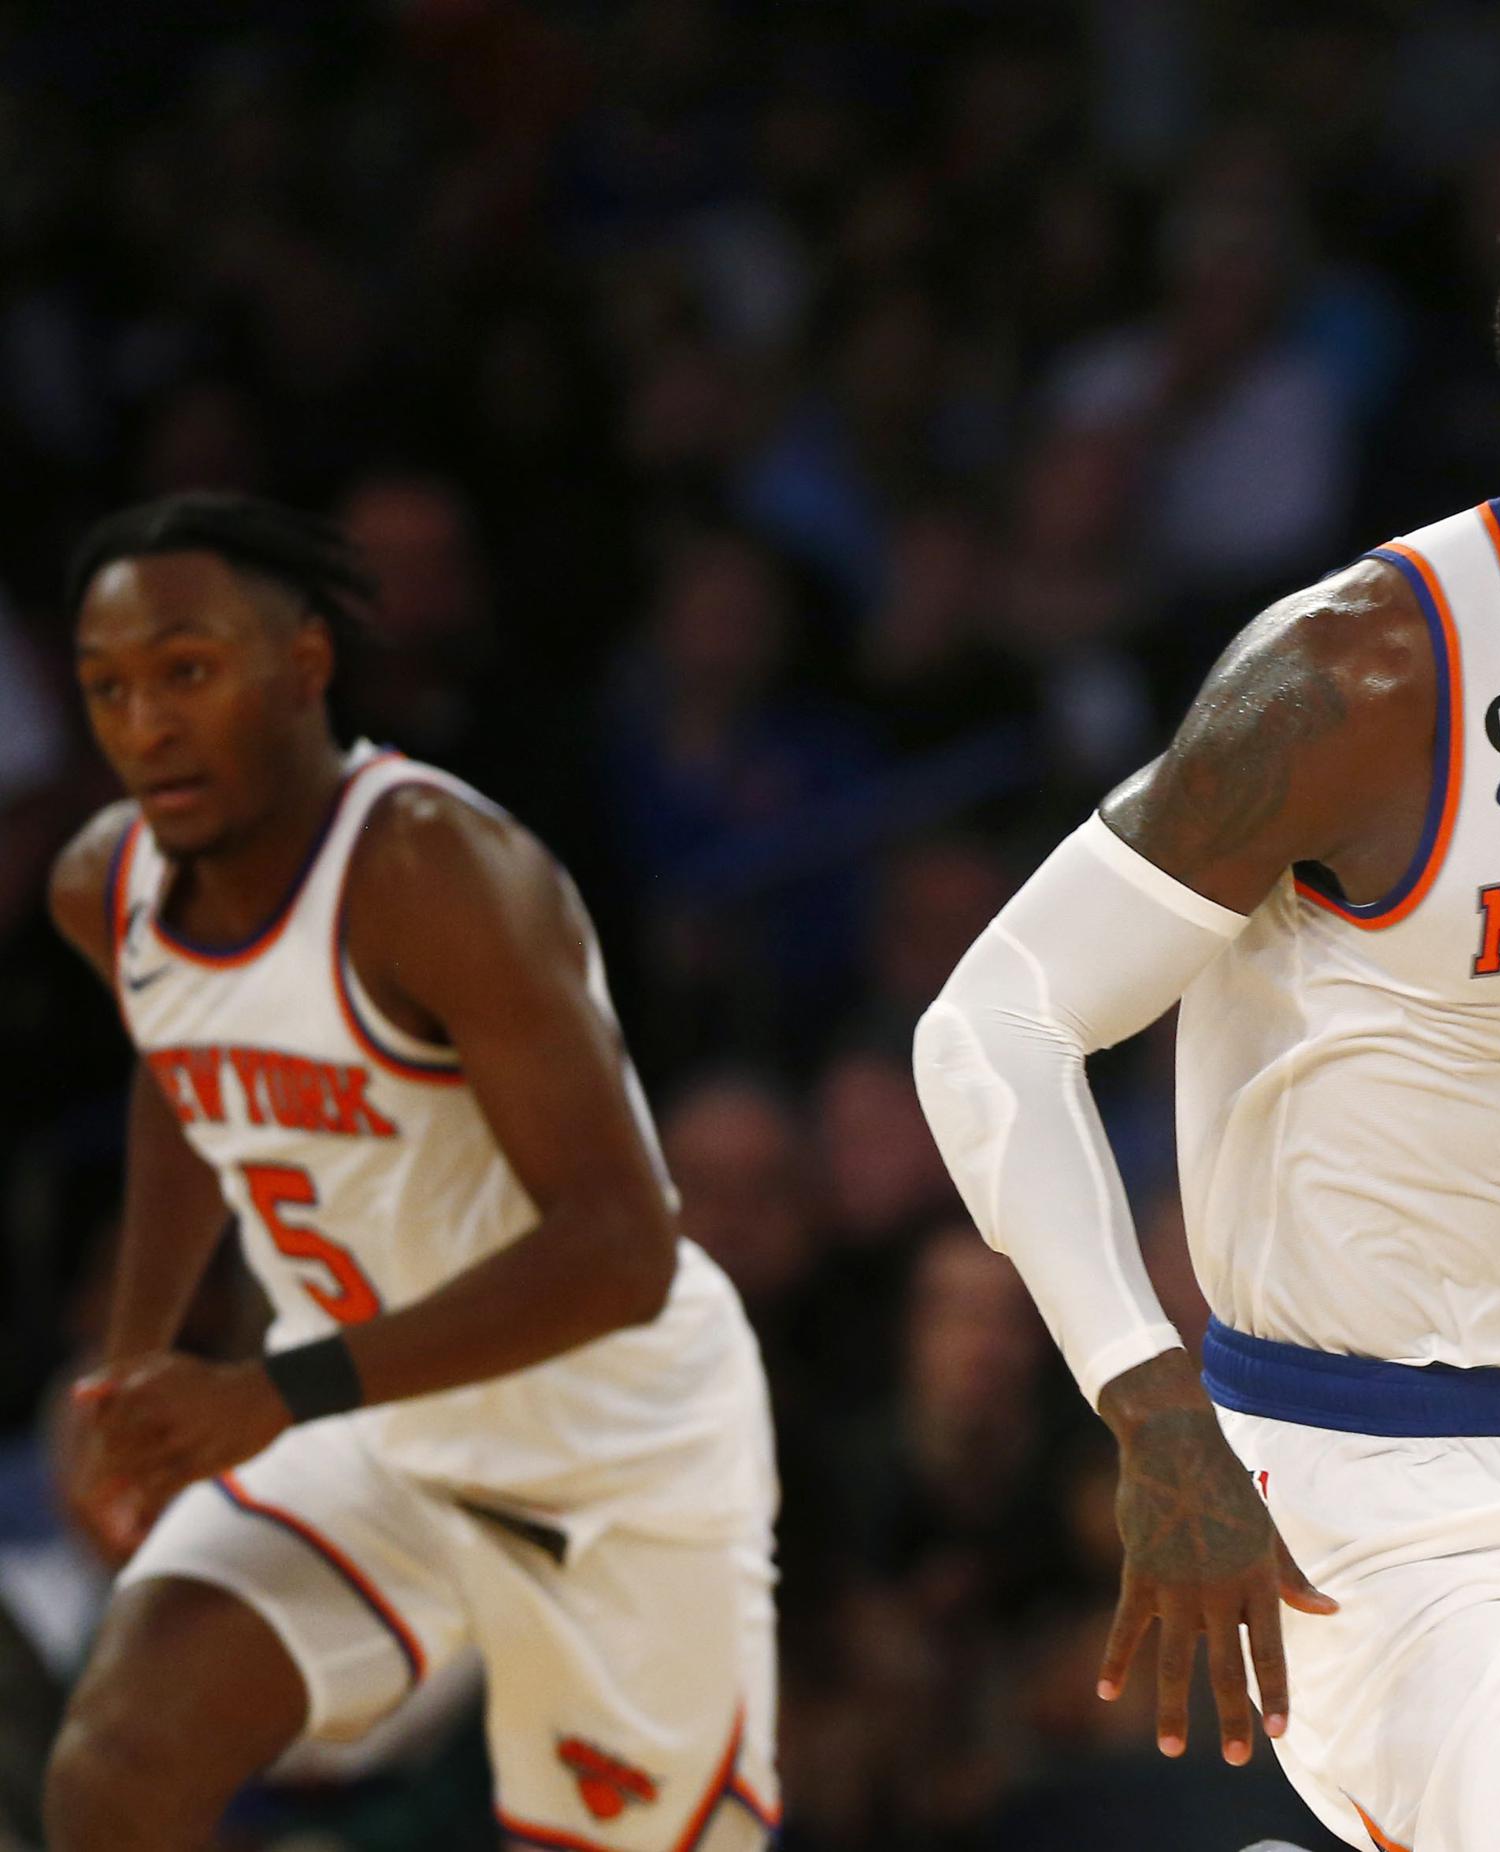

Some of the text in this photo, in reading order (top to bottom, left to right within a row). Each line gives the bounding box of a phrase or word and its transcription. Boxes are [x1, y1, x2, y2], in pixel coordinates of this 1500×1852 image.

[145, 1045, 398, 1138] EW YORK
[238, 1161, 382, 1325] 5
